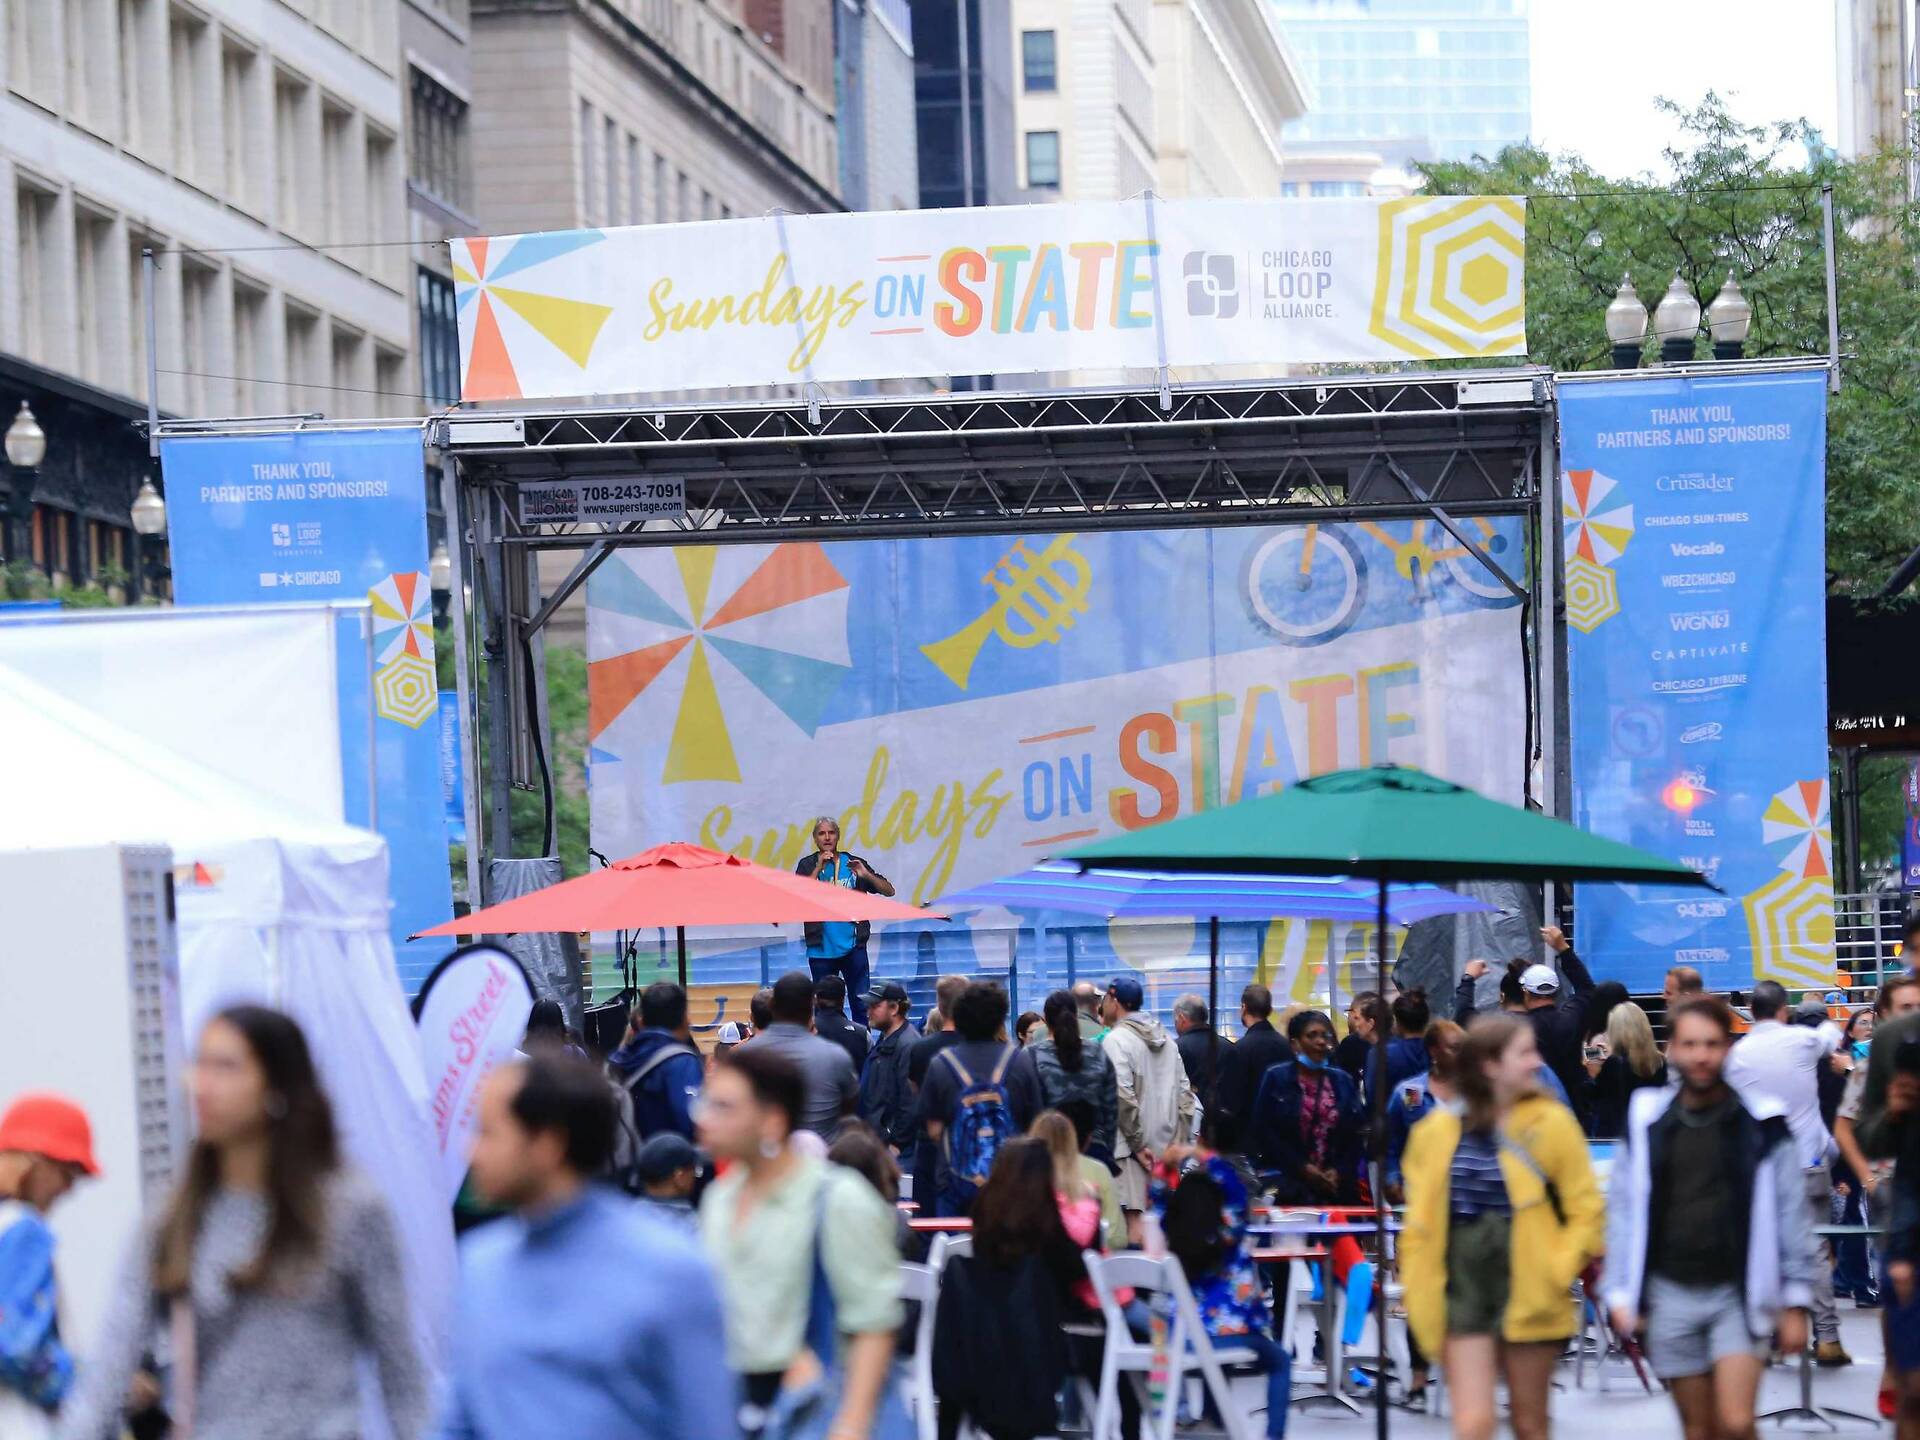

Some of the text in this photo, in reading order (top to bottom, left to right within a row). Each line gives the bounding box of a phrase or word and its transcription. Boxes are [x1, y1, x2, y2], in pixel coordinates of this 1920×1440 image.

[1262, 250, 1332, 268] CHICAGO
[1263, 272, 1332, 299] LOOP
[643, 240, 1160, 373] Sundays ON STATE
[1650, 405, 1735, 425] THANK YOU,
[1597, 423, 1791, 449] PARTNERS AND SPONSORS!
[251, 461, 335, 481] THANK YOU,
[200, 480, 389, 503] PARTNERS AND SPONSORS!
[582, 483, 682, 501] 708-243-7091
[1656, 473, 1735, 492] Crusader
[583, 502, 682, 515] www.superstage.com
[1644, 515, 1690, 527] CHICAGO
[1670, 542, 1725, 556] Vocalo
[295, 570, 341, 585] CHICAGO
[1651, 642, 1748, 661] CAPTIVATE
[1652, 673, 1748, 691] CHICAGO TRIBUNE
[1022, 753, 1093, 822] ON
[1108, 661, 1421, 832] STATE
